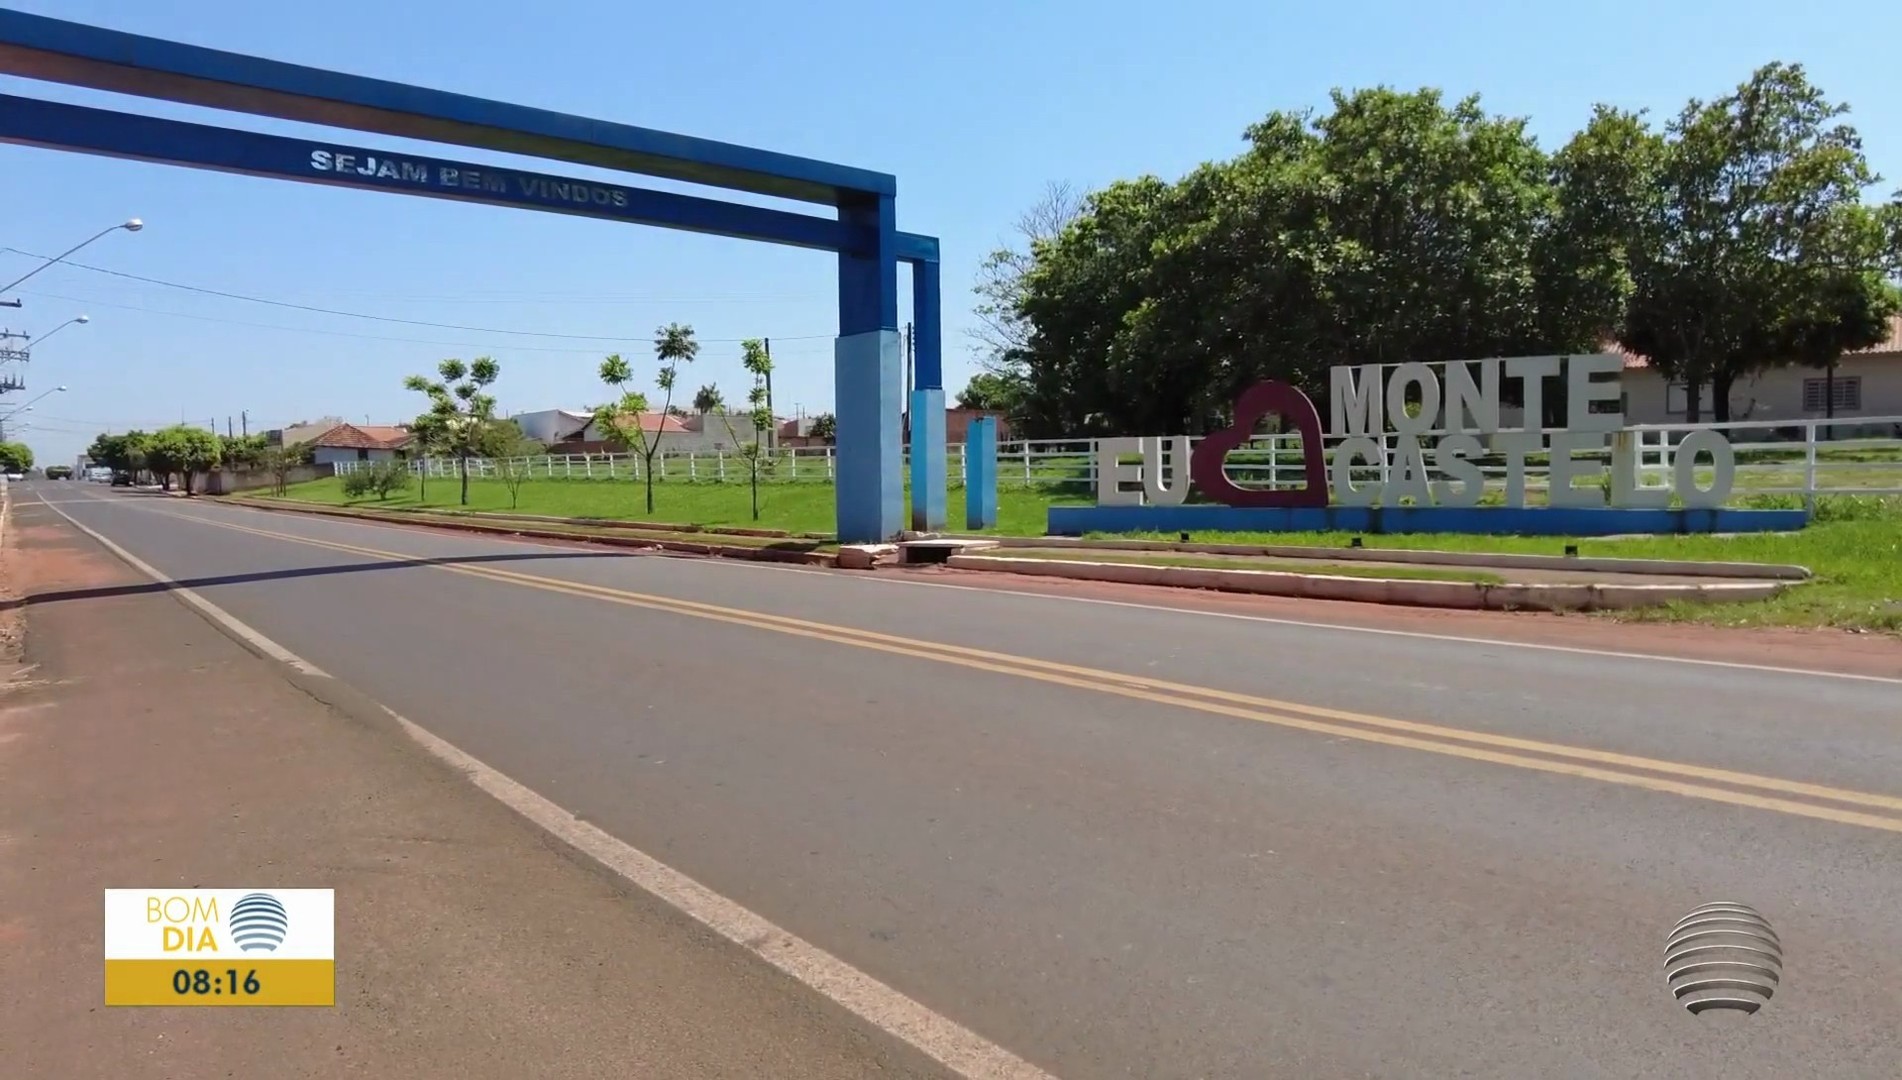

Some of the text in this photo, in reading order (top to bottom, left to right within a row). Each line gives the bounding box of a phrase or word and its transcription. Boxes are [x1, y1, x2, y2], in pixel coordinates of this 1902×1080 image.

[310, 150, 629, 208] SEJAM BEM VINDOS
[1330, 353, 1624, 437] MONTE
[1097, 435, 1191, 507] EU
[1331, 428, 1736, 510] CASTELO
